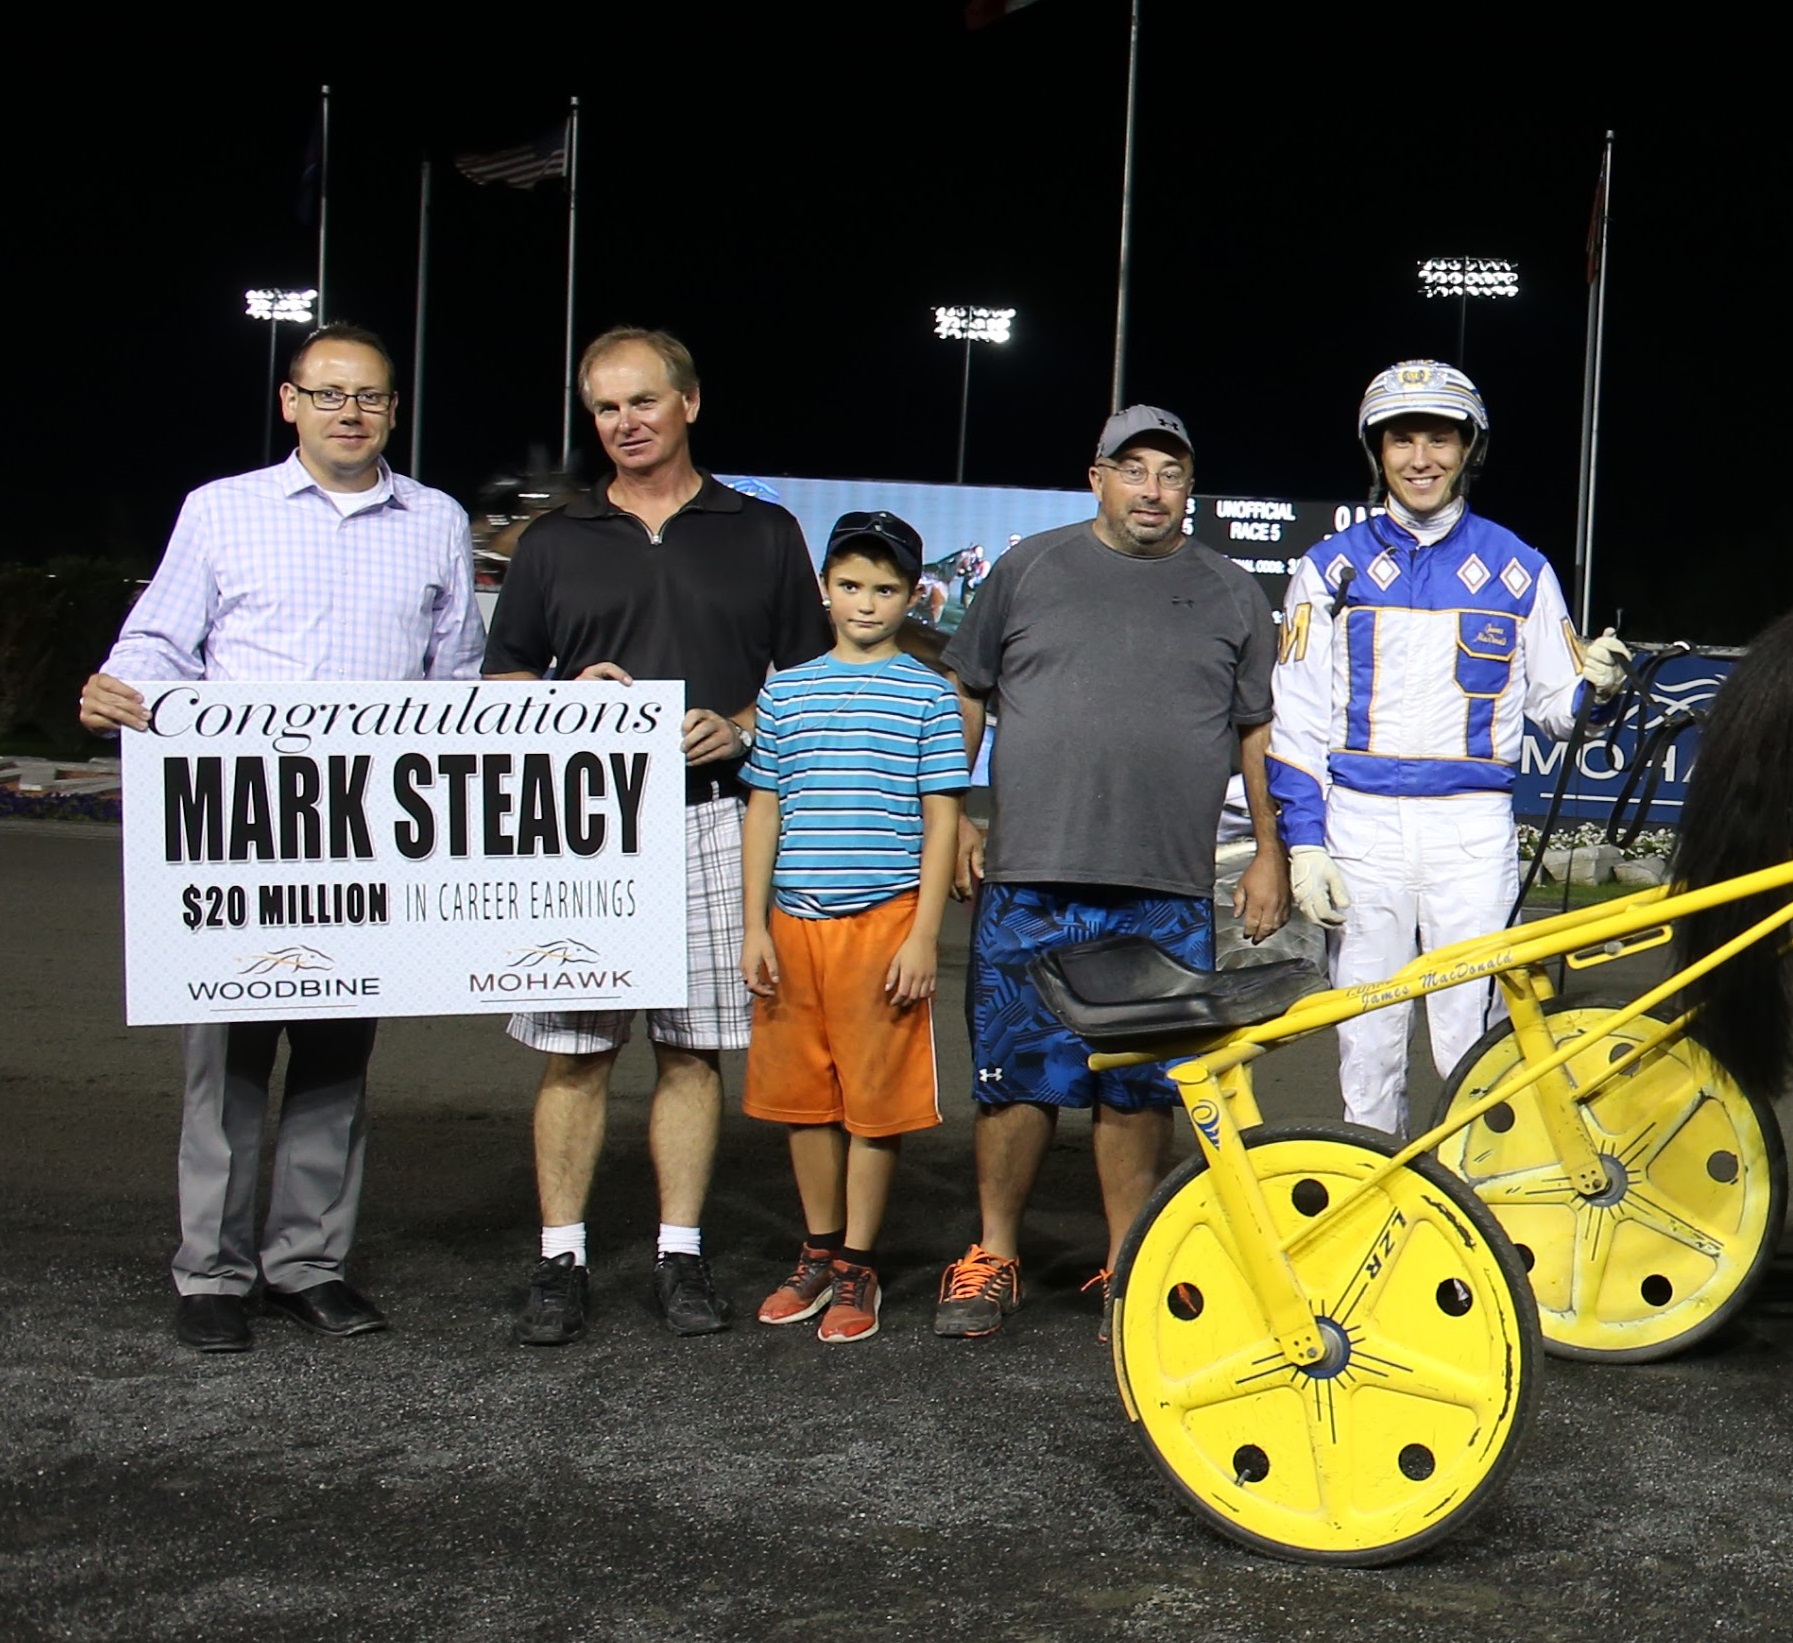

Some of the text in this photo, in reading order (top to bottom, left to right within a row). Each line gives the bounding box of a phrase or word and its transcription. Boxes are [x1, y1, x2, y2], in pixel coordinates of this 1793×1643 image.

[1216, 500, 1296, 521] UNOFFICIAL
[1230, 521, 1281, 541] RACE 5
[149, 686, 662, 754] Congratulations
[163, 750, 649, 863] MARK STEACY
[182, 879, 636, 931] $20 MILLION IN CAREER EARNINGS
[187, 977, 381, 1001] WOODBINE
[469, 970, 633, 992] MOHAWK
